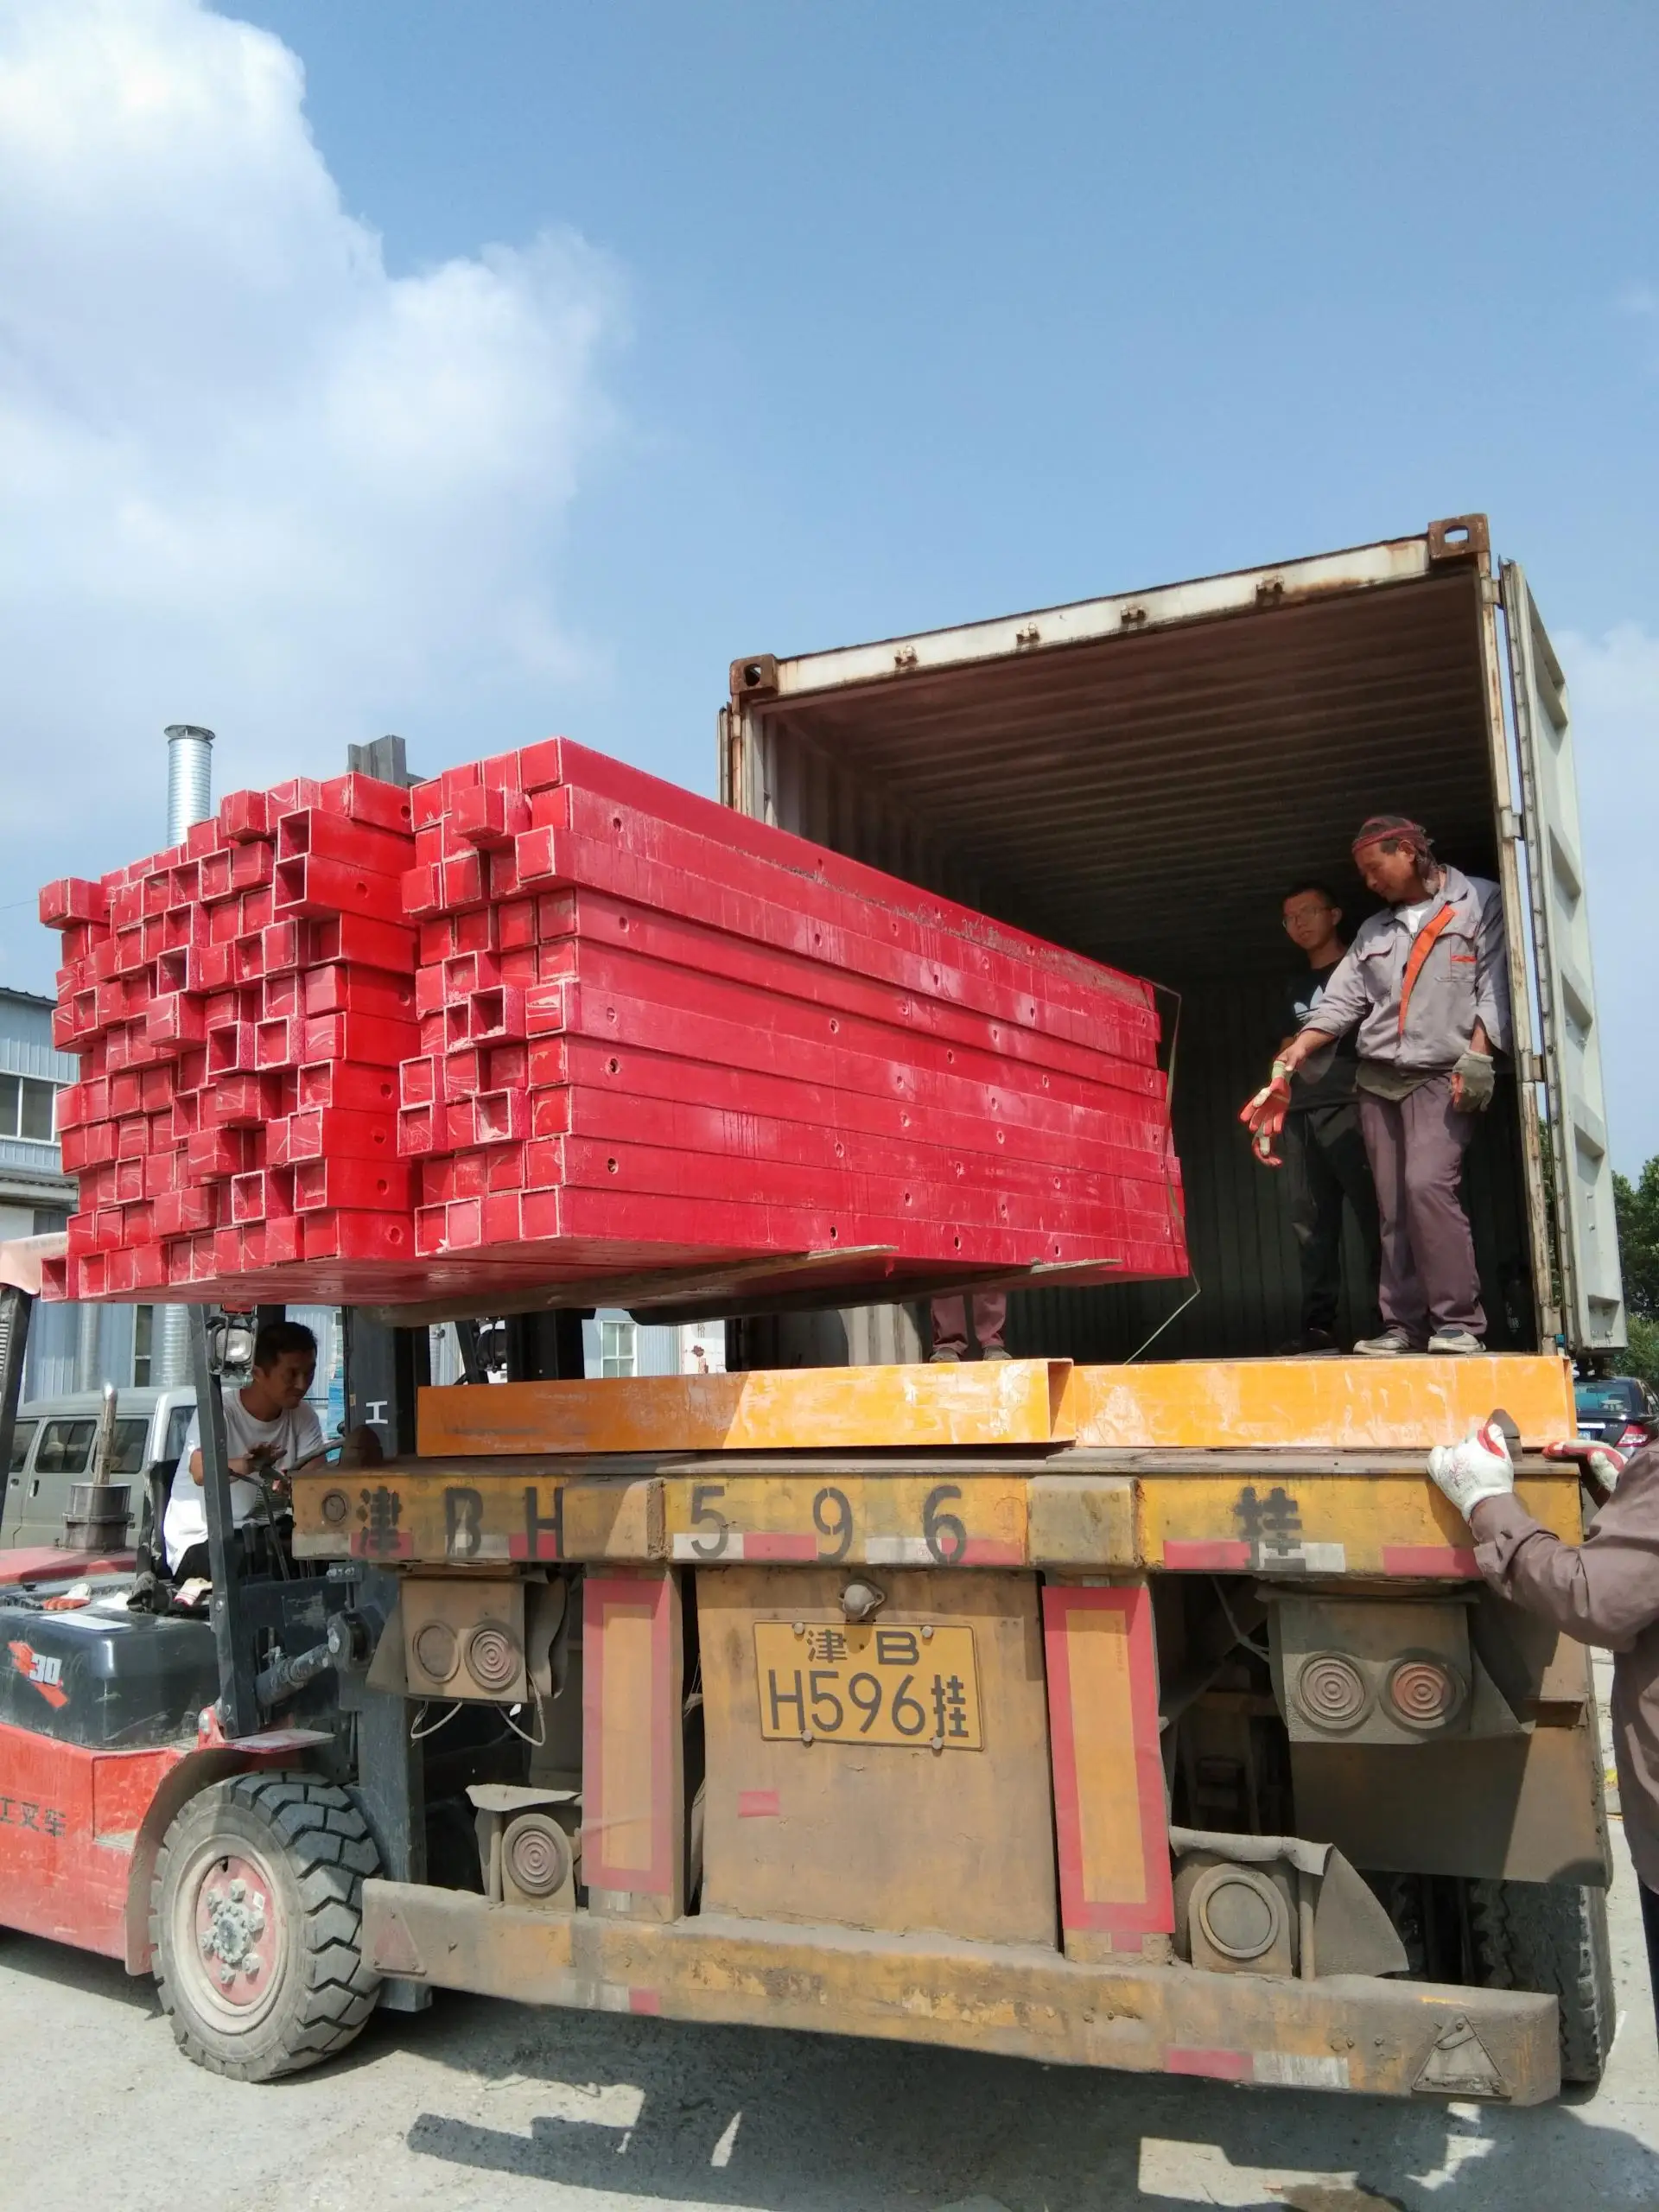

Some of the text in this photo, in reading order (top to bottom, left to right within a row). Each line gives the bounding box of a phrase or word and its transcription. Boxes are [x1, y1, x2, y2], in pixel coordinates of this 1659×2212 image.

[1233, 1486, 1306, 1571] 挂
[29, 1653, 63, 1686] 30
[806, 1629, 920, 1666] 津B
[768, 1669, 969, 1738] H596挂
